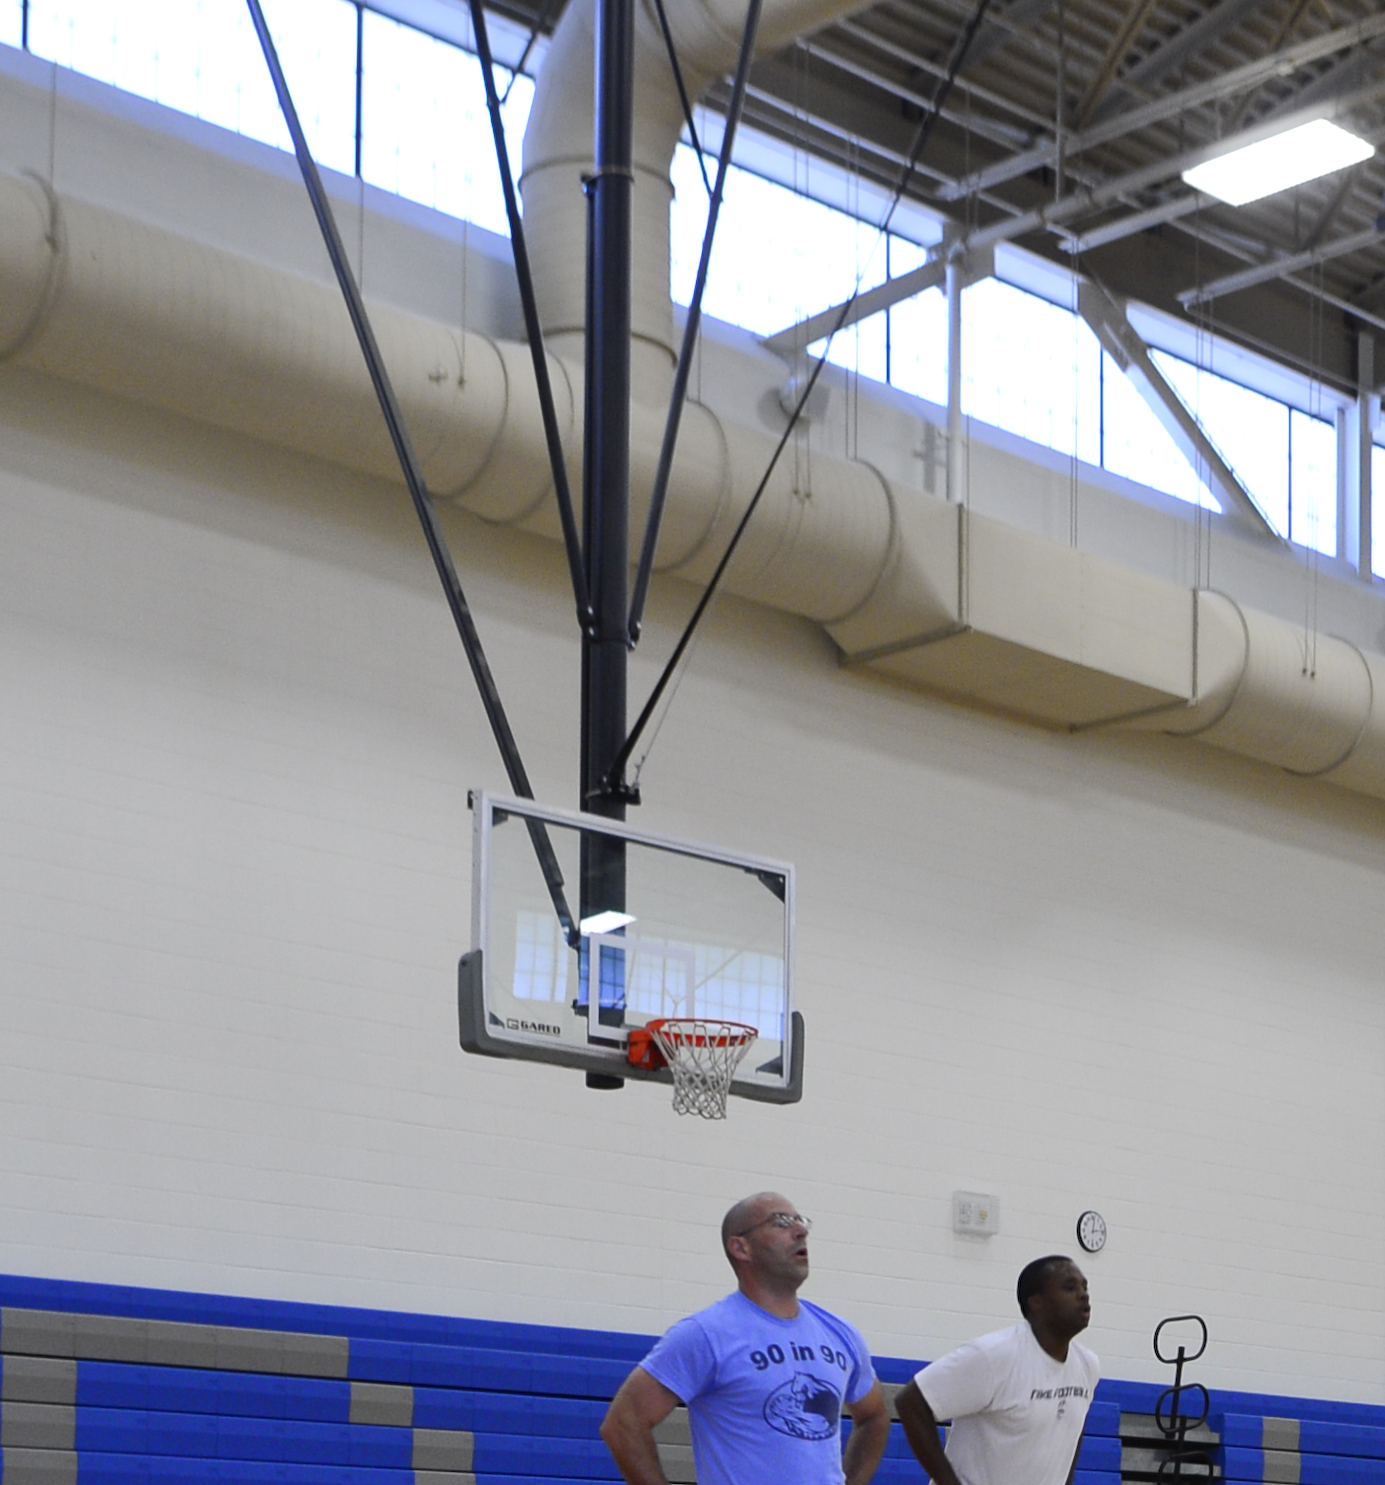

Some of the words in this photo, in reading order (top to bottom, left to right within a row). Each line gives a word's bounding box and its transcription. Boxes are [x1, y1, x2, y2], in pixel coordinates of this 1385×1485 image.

[750, 1344, 785, 1371] 90
[789, 1341, 815, 1361] in
[820, 1345, 847, 1371] 90
